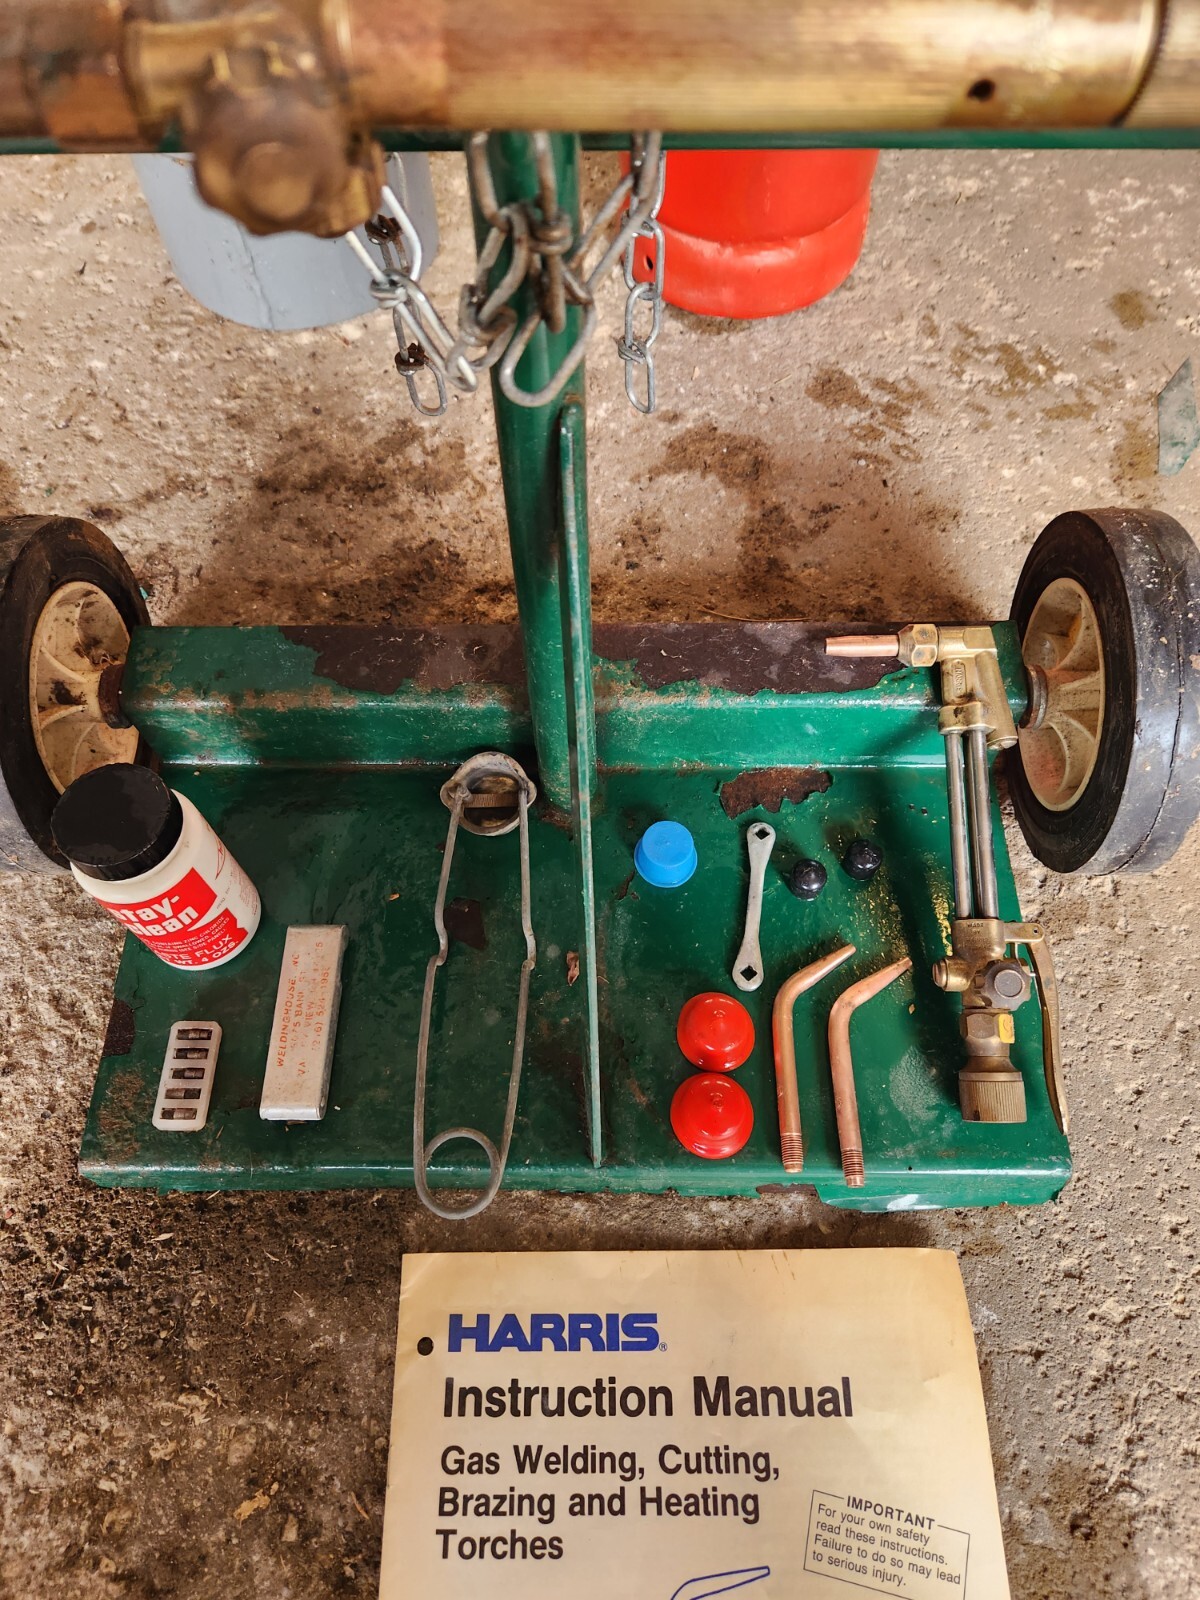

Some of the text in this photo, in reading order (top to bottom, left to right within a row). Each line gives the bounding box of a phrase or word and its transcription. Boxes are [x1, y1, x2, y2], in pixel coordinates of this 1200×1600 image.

[195, 934, 233, 957] FLUX
[448, 1313, 660, 1352] HARRIS
[444, 1376, 853, 1418] Instruction Manual
[441, 1444, 780, 1482] Gas Welding, Cutting,
[438, 1486, 760, 1525] Brazing and Heating
[818, 1503, 930, 1546] For your own safety
[847, 1495, 935, 1530] IMPORTANT
[436, 1529, 564, 1561] Torches
[814, 1533, 961, 1585] Failure to do so may lead
[816, 1520, 948, 1566] read these instructions.
[812, 1549, 906, 1587] to serious injury.
